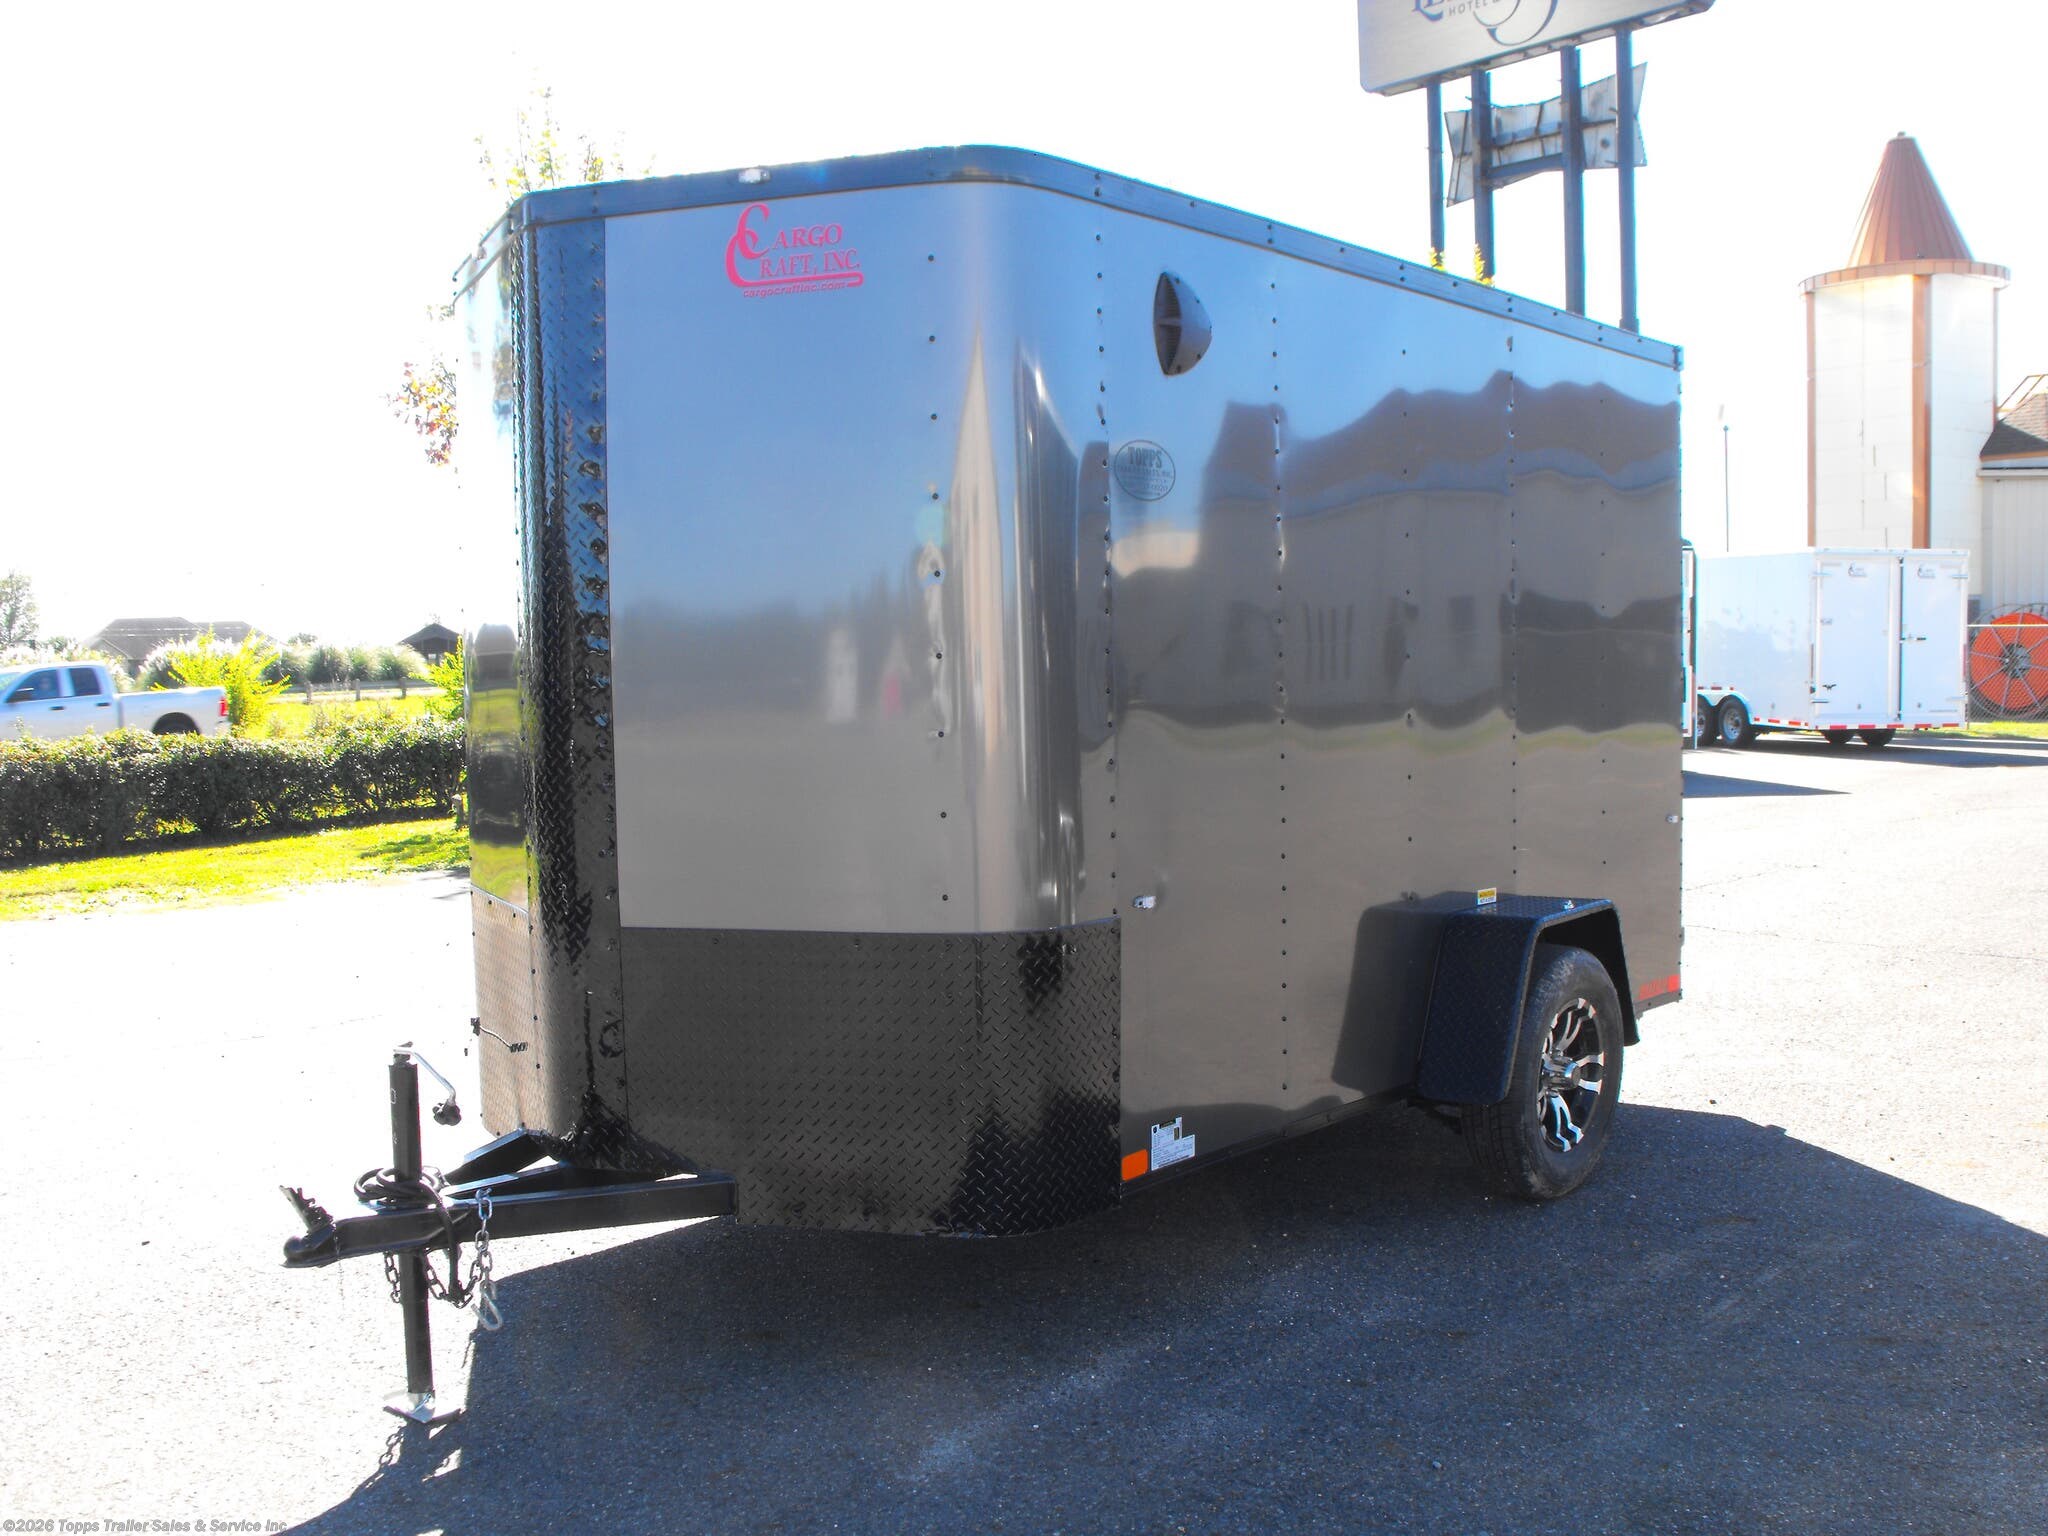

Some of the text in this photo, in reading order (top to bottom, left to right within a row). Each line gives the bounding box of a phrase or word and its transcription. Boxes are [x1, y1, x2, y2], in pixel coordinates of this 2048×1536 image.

[1448, 0, 1487, 16] HOTEL
[737, 203, 843, 259] CARGO
[823, 249, 861, 271] INC.
